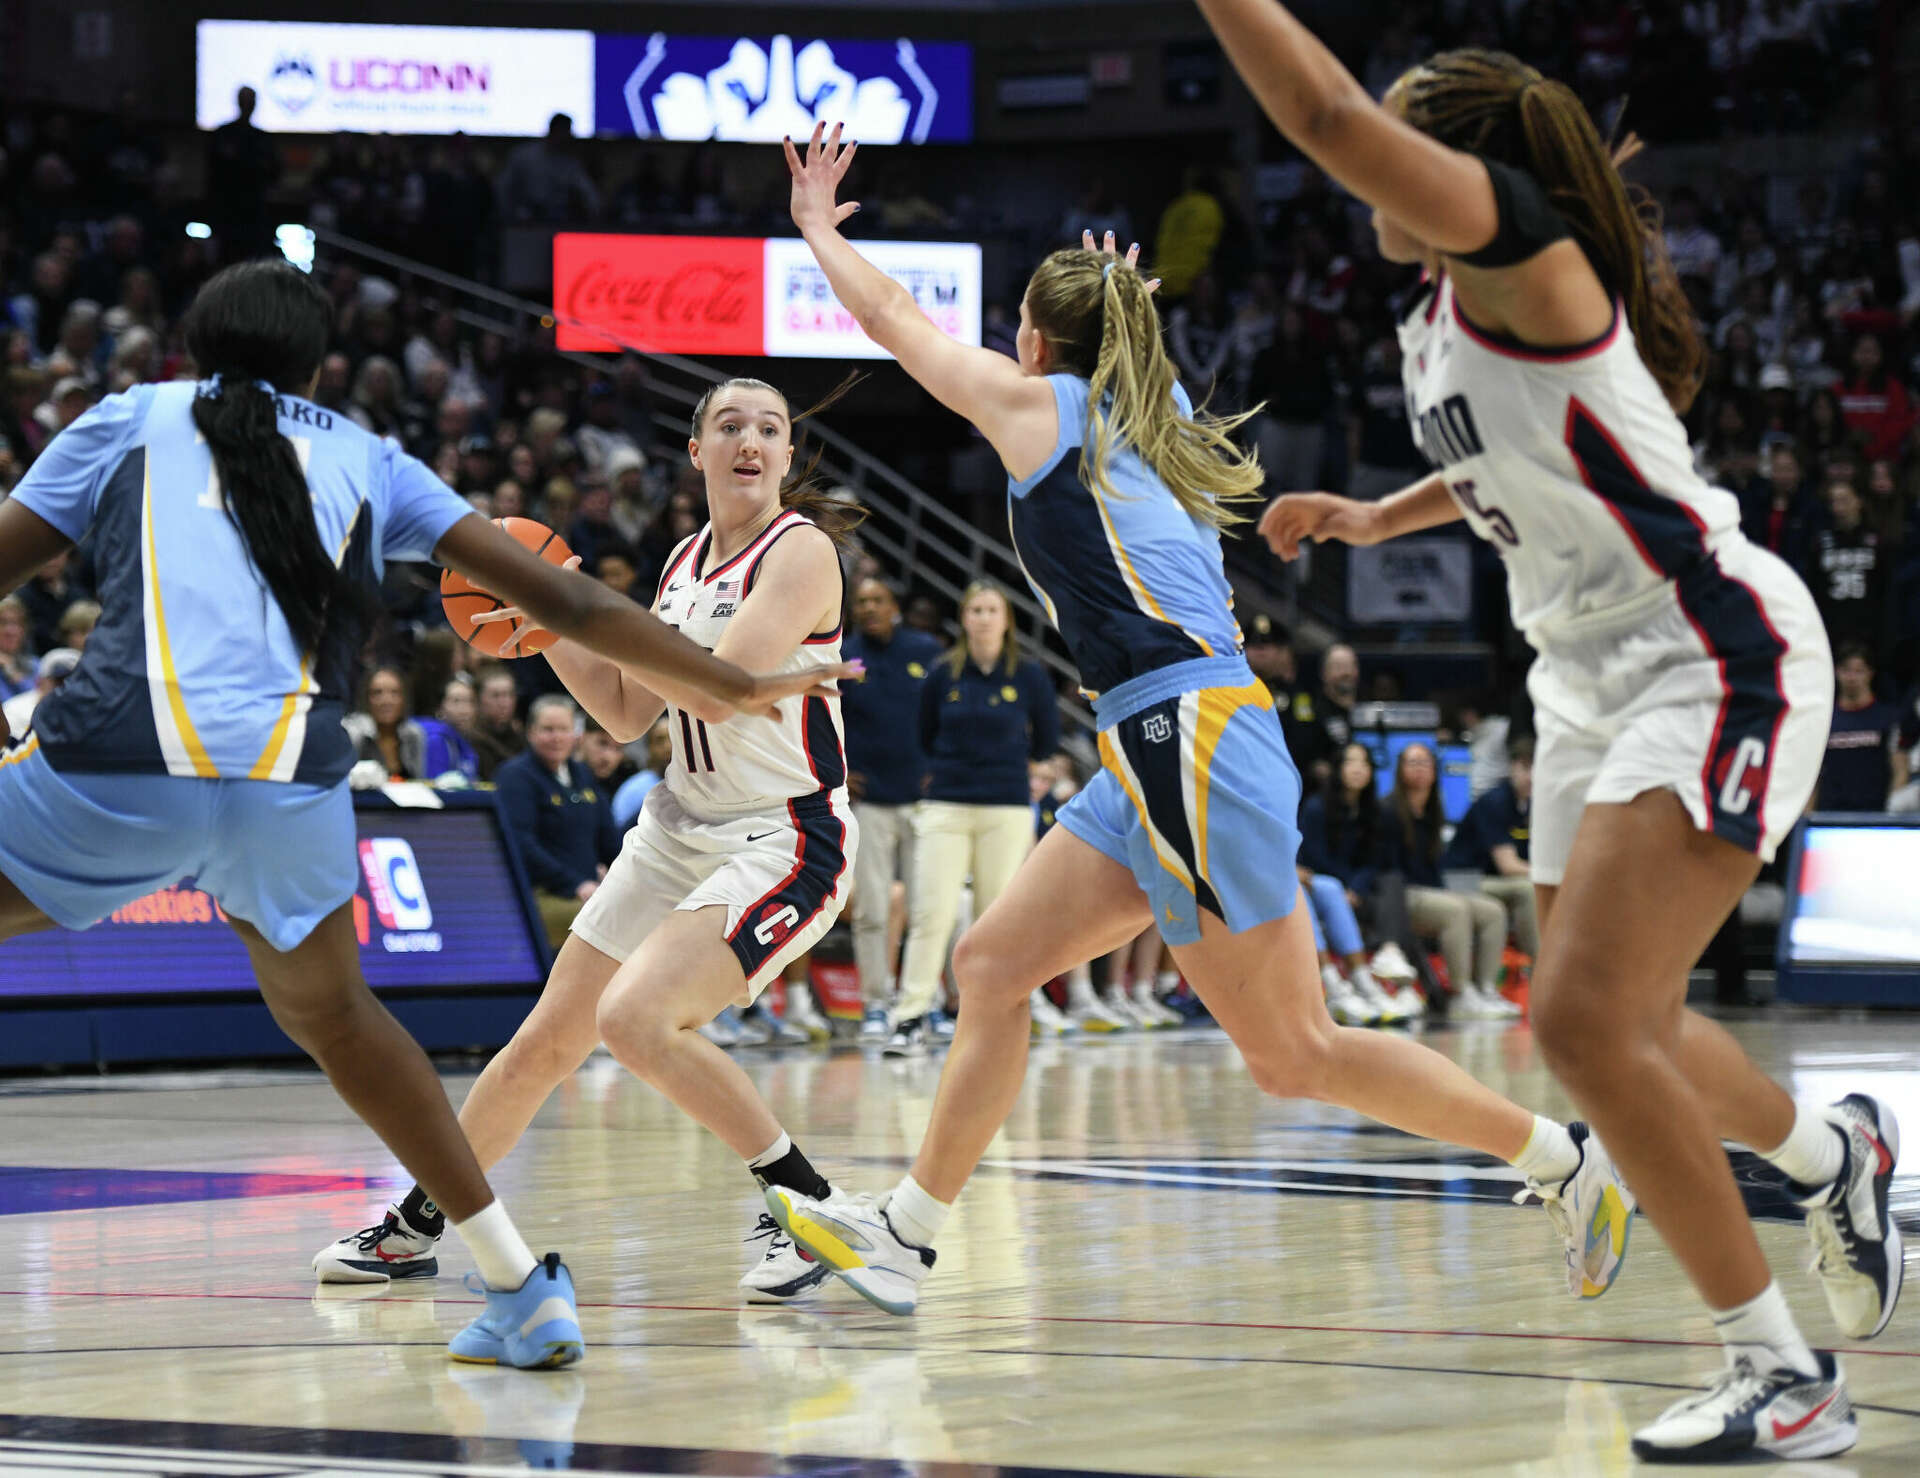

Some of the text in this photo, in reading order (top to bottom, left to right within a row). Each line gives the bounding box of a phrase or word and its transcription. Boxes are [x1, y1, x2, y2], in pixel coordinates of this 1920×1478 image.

[329, 60, 489, 92] UCONN
[716, 602, 735, 610] BIG
[678, 708, 716, 774] 11
